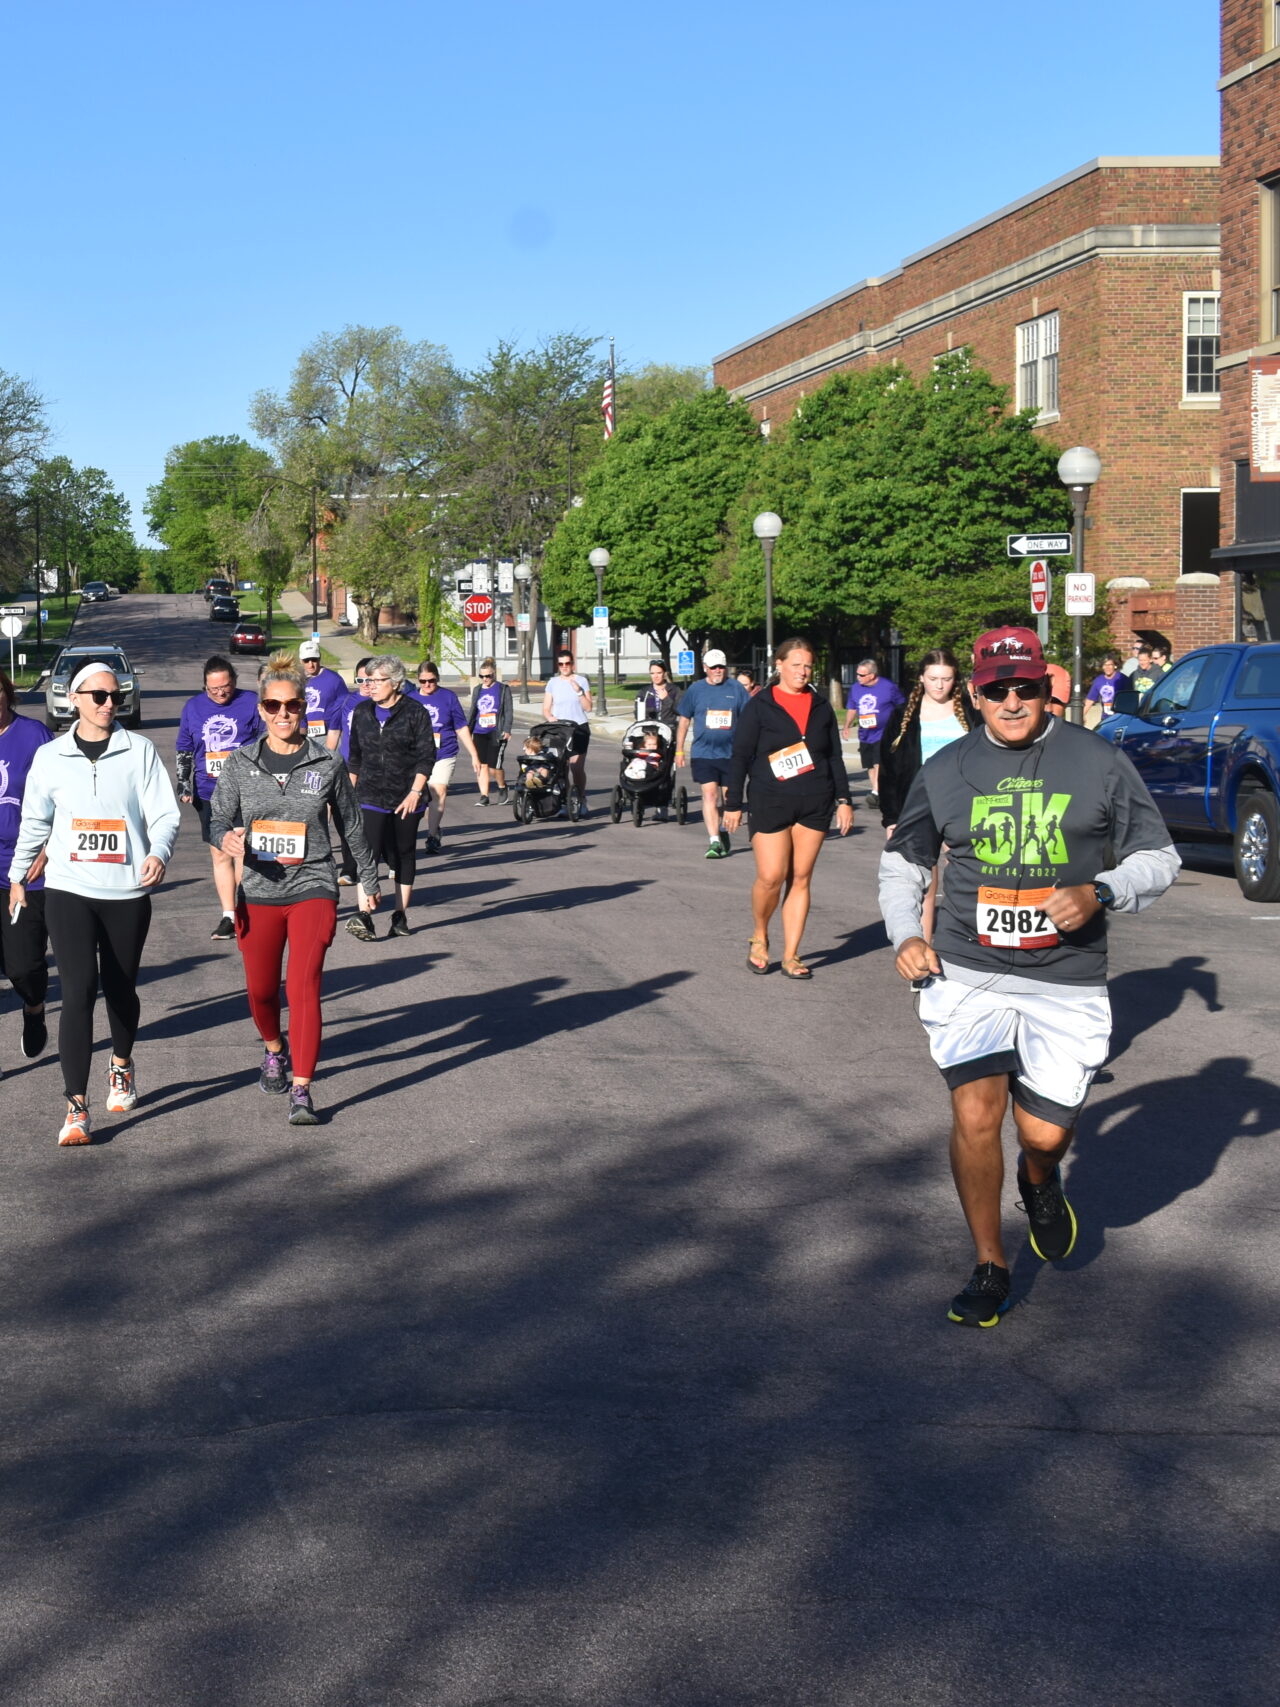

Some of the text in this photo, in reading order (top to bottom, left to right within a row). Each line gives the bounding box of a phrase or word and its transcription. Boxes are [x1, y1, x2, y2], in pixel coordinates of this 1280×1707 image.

[1251, 370, 1262, 467] Historic Downtown
[1027, 540, 1064, 549] ONE WAY
[1073, 583, 1087, 591] NO
[1068, 595, 1093, 603] PARKING
[466, 602, 492, 613] STOP
[210, 761, 221, 771] 29
[970, 792, 1072, 865] 5K
[78, 833, 118, 851] 2970
[259, 836, 296, 854] 3165
[981, 866, 1000, 875] MAY
[1029, 867, 1057, 877] 2022
[984, 889, 1019, 901] GOPHER
[986, 908, 1048, 934] 2982
